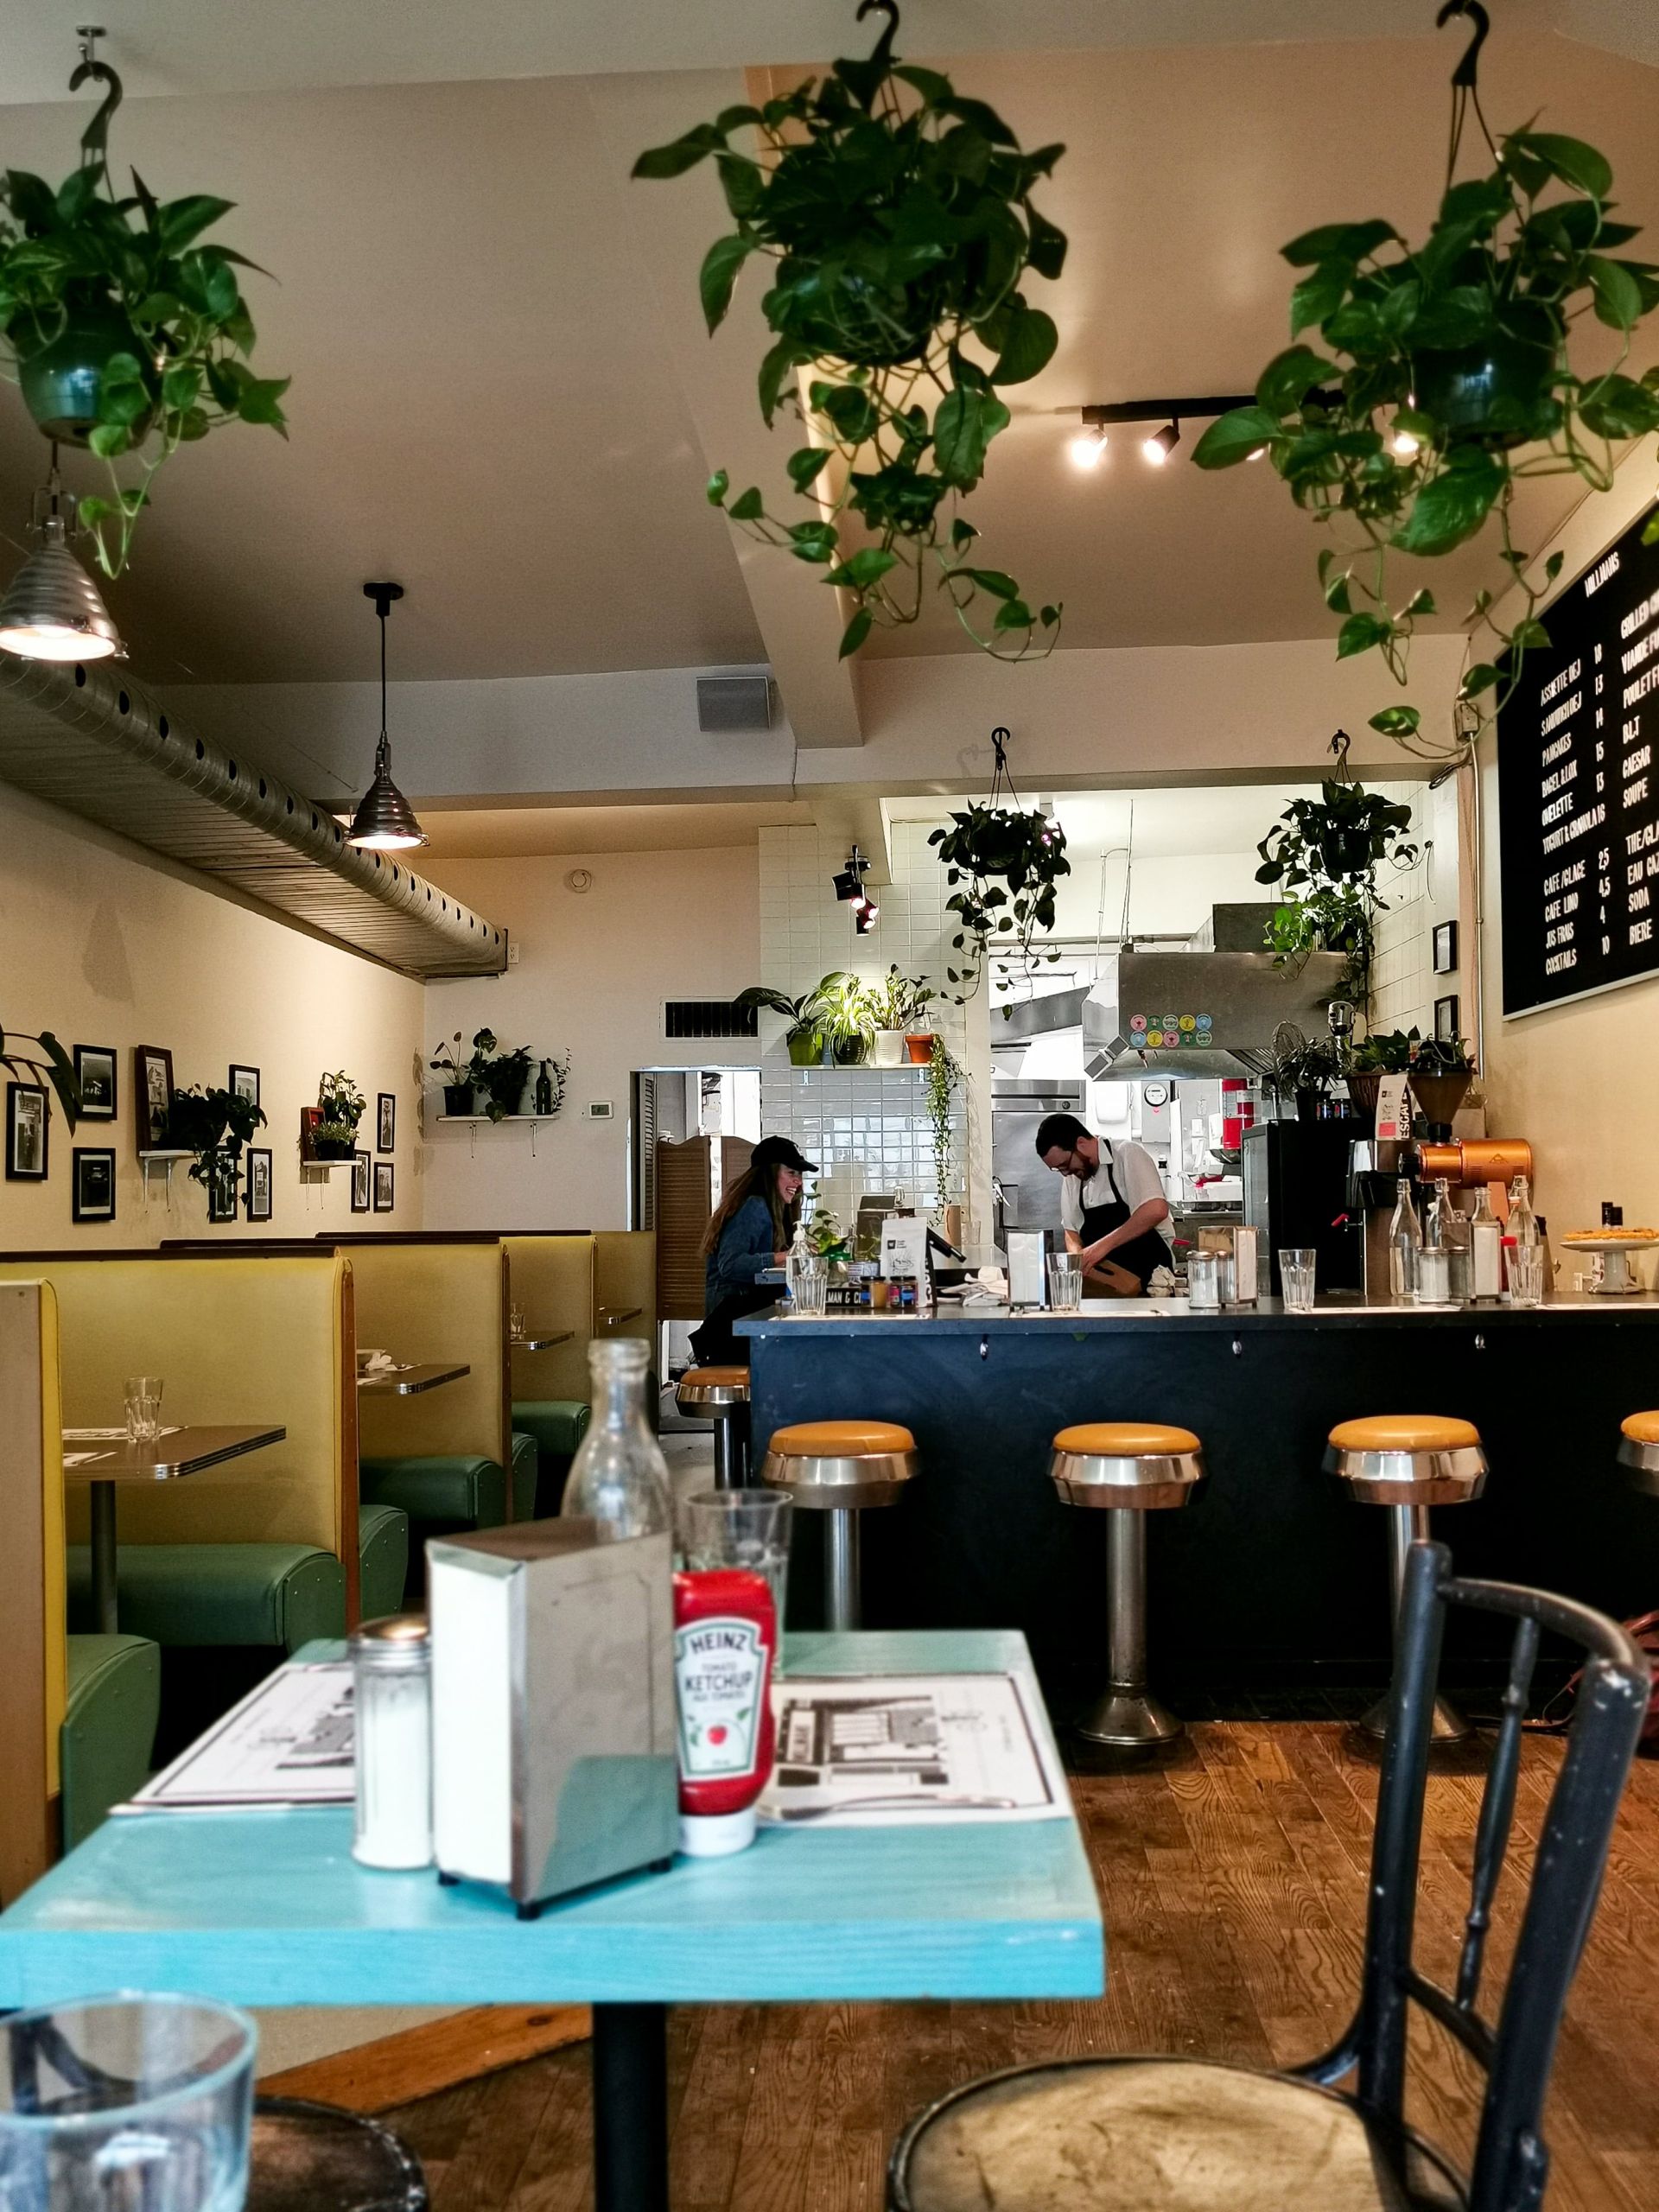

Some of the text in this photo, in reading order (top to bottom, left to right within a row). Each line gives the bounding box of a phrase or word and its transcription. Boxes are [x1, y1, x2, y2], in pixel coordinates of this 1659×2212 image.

[1541, 669, 1568, 707] ASSIETTE
[1595, 674, 1603, 696] 13
[1623, 671, 1651, 709] POULET
[1541, 732, 1572, 767] PANCAKES
[1623, 745, 1651, 779] CAESAR
[1541, 772, 1560, 798] BAGEL
[1596, 741, 1605, 762] 15
[1541, 771, 1605, 827] OMELETTE 13
[1623, 777, 1649, 809] SOUPE
[1543, 872, 1560, 897] CAFE
[1627, 861, 1643, 885] EAU
[1545, 899, 1561, 923] CAFE
[1628, 887, 1649, 912] SODA
[1546, 905, 1606, 950] JUS FRAIS 4
[1629, 918, 1652, 945] BIERE
[1546, 935, 1611, 976] COCKTAILS 10
[690, 1631, 747, 1655] HEINZ
[685, 1671, 753, 1692] KETCHUP
